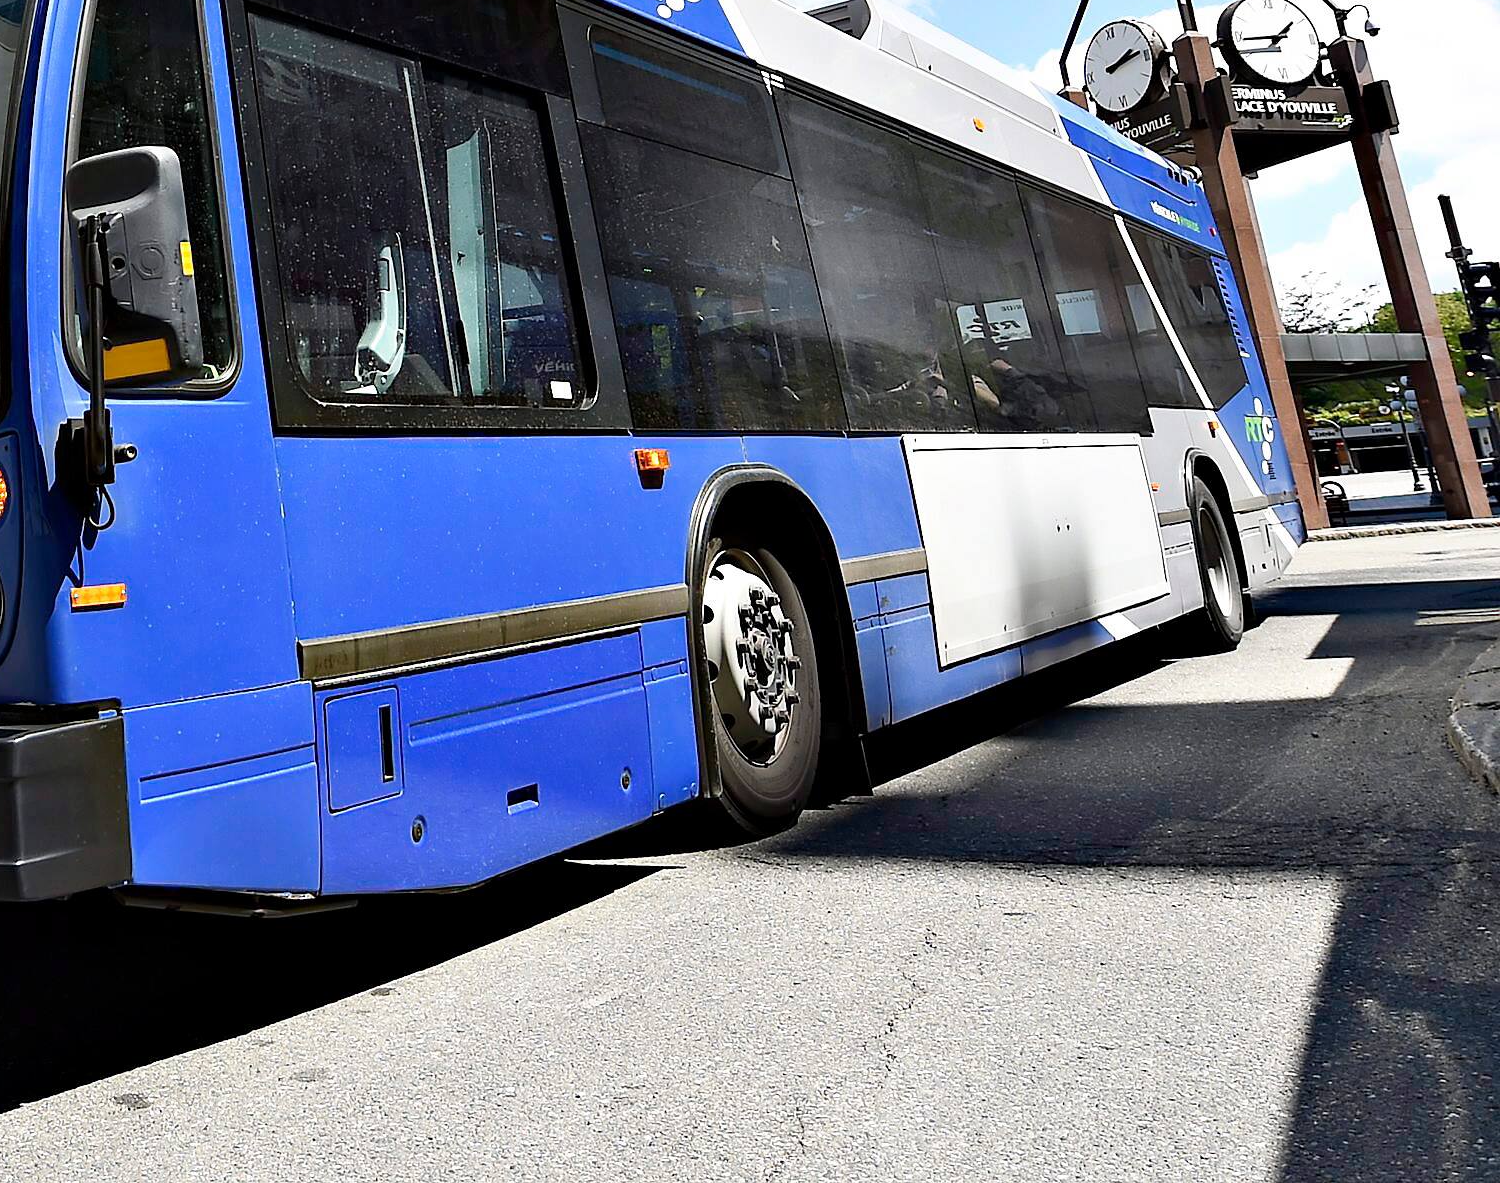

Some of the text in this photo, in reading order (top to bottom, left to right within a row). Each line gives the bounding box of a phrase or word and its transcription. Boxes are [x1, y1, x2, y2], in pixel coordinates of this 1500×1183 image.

[1231, 87, 1286, 100] ERMINUS
[1234, 101, 1337, 114] LACE D'YOUVILLE
[1123, 114, 1172, 139] YOUVILLE
[1244, 416, 1274, 443] RTC
